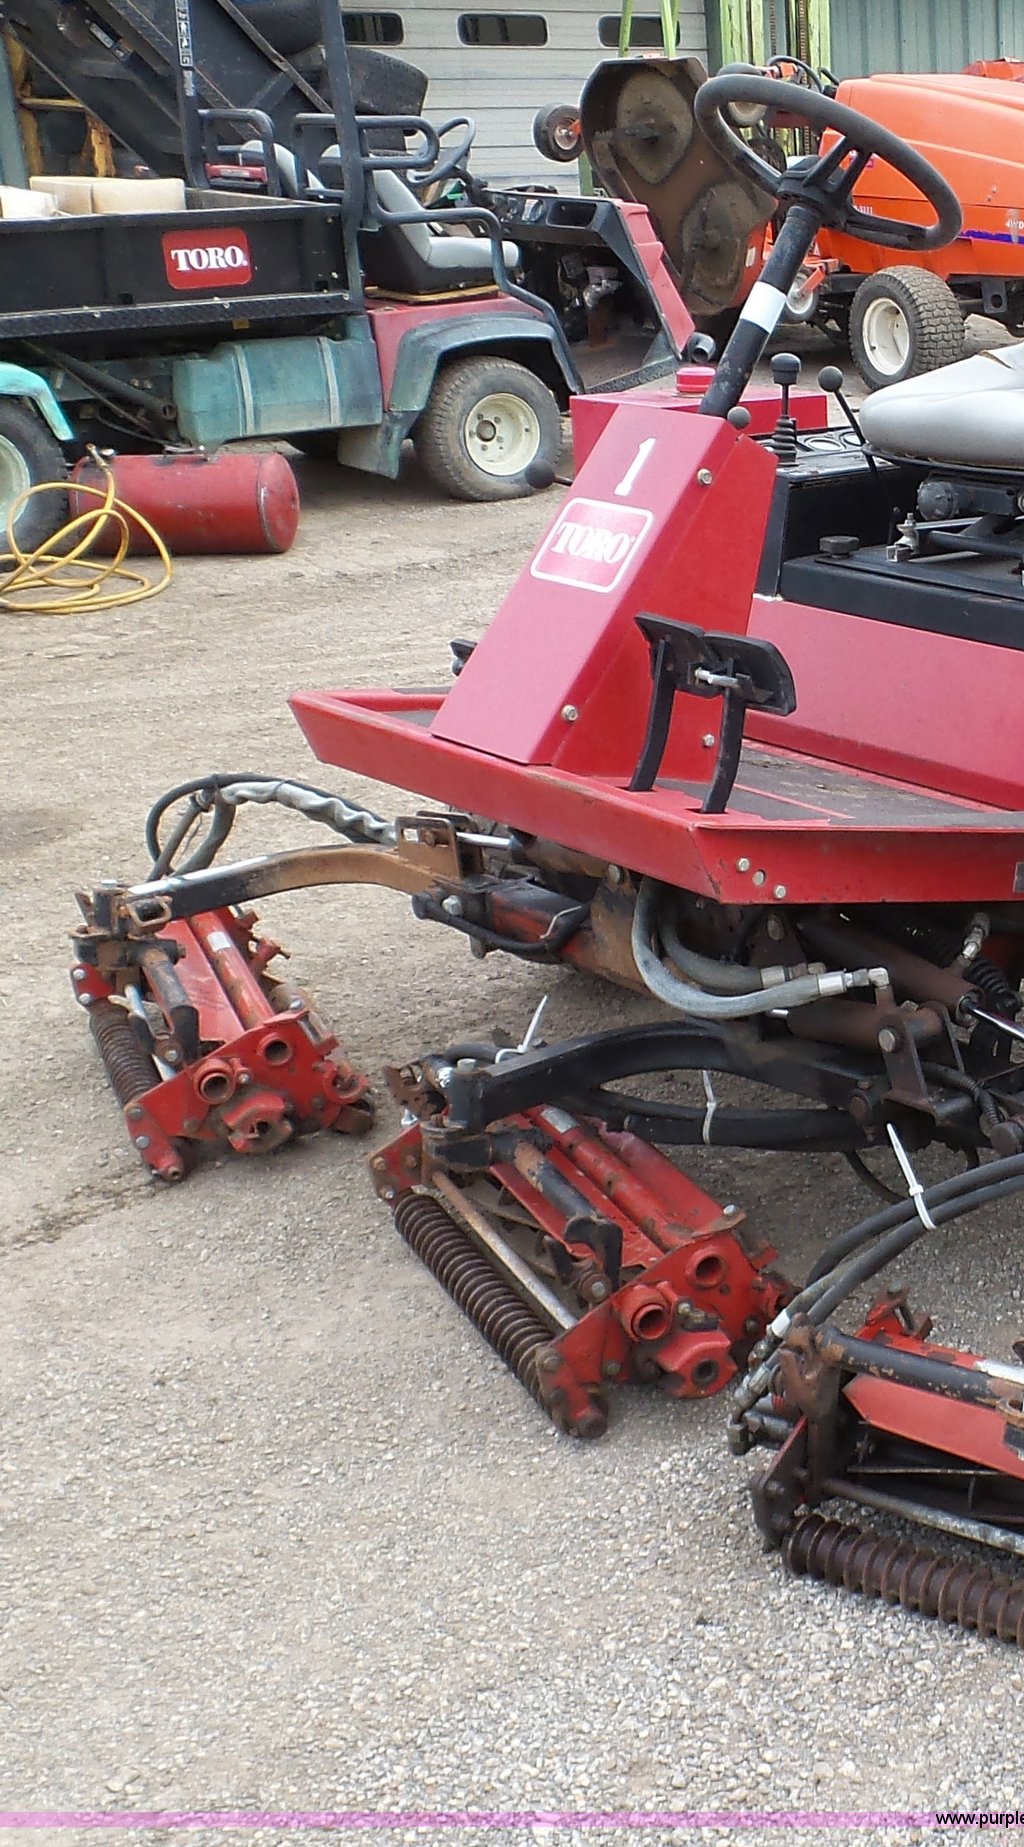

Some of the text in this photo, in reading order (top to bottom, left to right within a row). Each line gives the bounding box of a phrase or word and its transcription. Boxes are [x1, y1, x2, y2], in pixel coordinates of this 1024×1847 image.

[170, 245, 244, 271] TORO
[614, 437, 656, 496] 1
[551, 522, 630, 564] TORO
